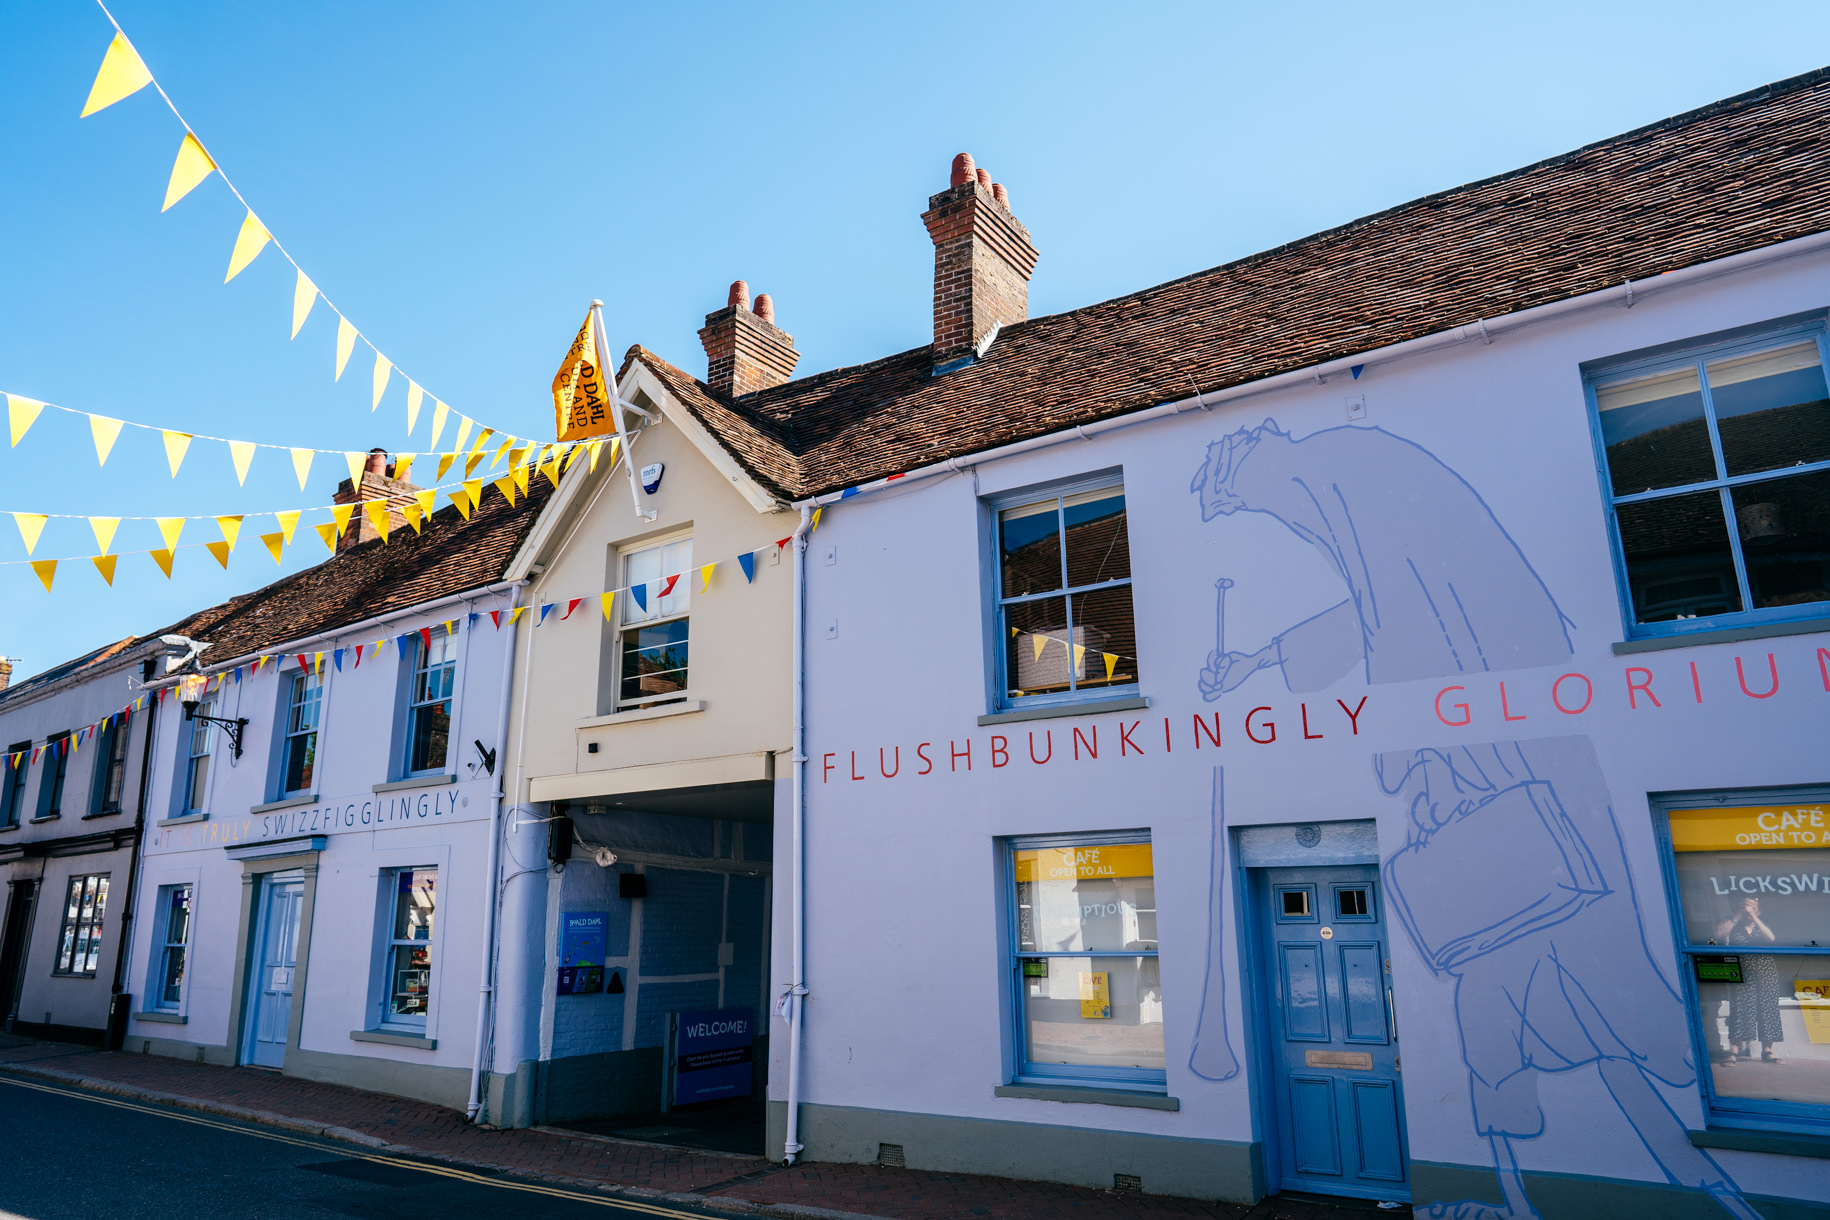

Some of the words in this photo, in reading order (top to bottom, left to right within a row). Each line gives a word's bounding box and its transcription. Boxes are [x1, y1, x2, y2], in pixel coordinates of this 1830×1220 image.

[560, 373, 575, 429] CENTRE
[573, 395, 588, 427] AND
[583, 381, 605, 425] DAHL
[823, 696, 1369, 784] FLUSHBUNKINGLY
[159, 829, 173, 849] IT
[179, 827, 193, 847] IS
[202, 818, 252, 844] TRULY
[262, 789, 460, 838] SWIZZFIGGLINGLY
[1757, 806, 1825, 831] CAFÉ
[1735, 832, 1785, 846] OPEN
[1788, 831, 1816, 843] TO
[1063, 848, 1101, 867] CAFÉ
[1050, 867, 1078, 878] OPEN
[1079, 866, 1095, 877] TO
[1096, 865, 1116, 877] ALL
[569, 918, 586, 926] ROALD
[1083, 976, 1102, 985] CAFÉ
[686, 1020, 746, 1038] WELCOME!
